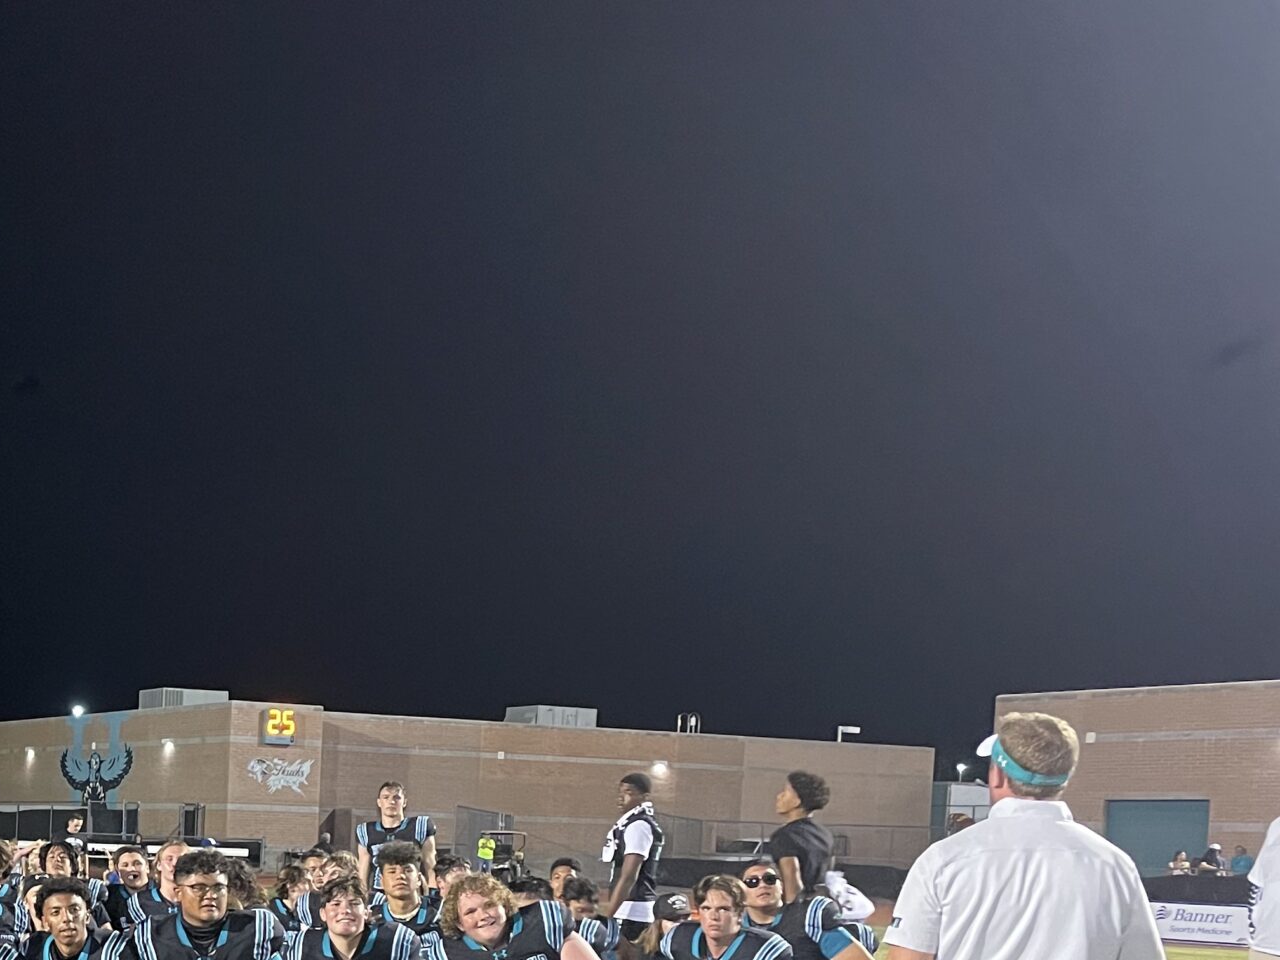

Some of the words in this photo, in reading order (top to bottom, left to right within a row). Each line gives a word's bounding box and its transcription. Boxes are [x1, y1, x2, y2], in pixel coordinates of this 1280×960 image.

[266, 707, 296, 736] 25
[1173, 907, 1234, 925] Banner
[1168, 924, 1195, 934] Sports
[1196, 925, 1233, 936] Medicine
